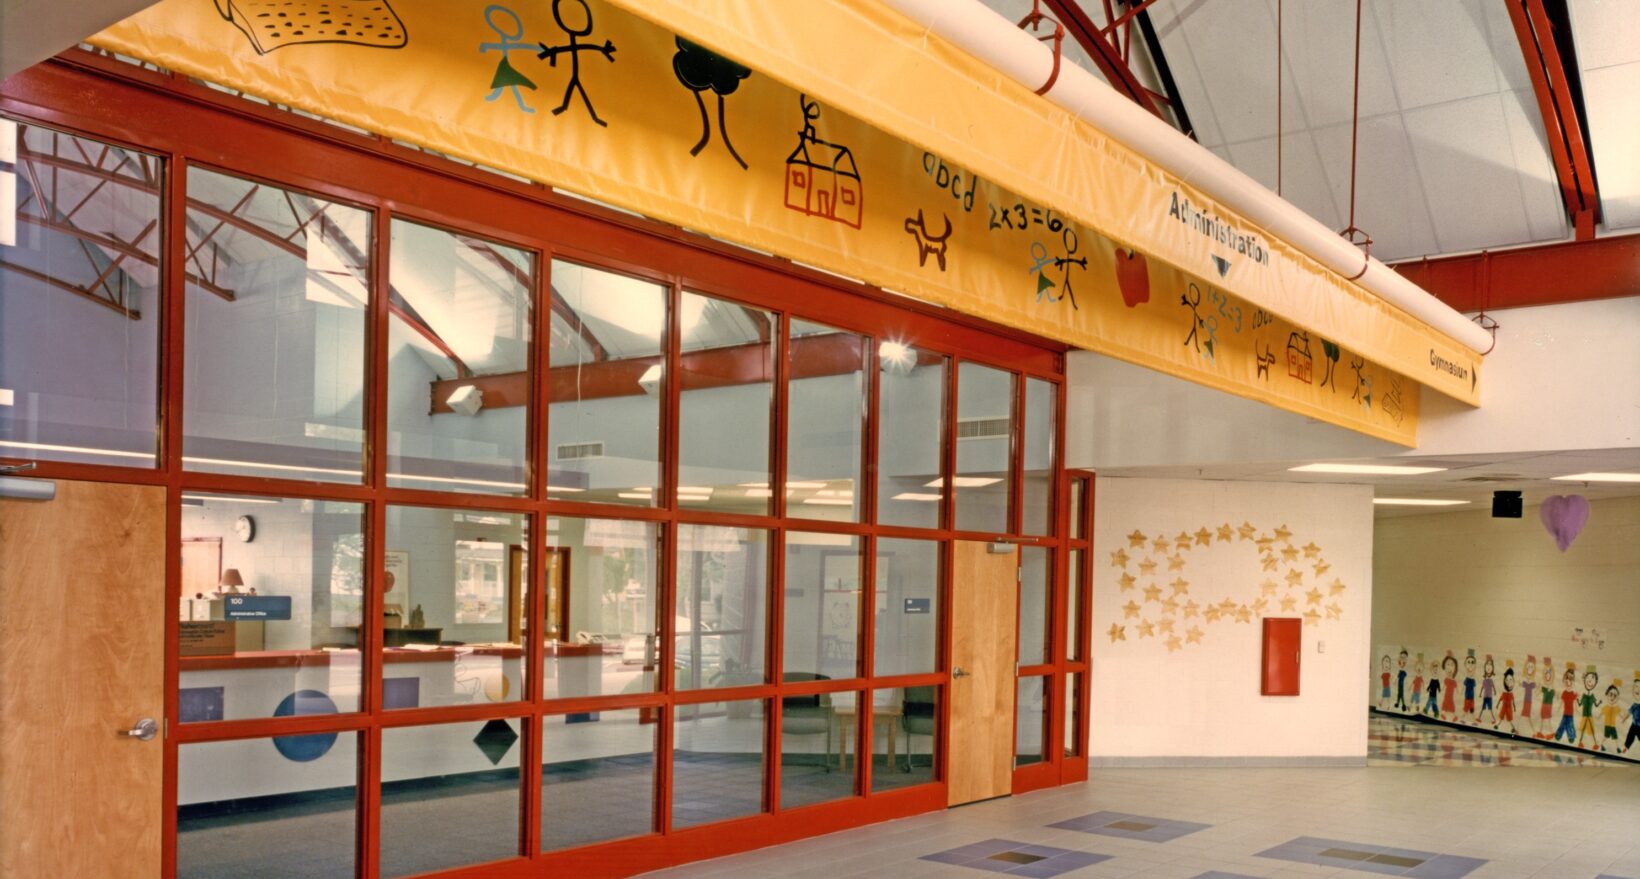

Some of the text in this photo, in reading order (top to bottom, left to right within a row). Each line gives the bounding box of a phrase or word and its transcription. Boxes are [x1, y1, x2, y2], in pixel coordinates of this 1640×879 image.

[923, 152, 977, 212] abcd
[1169, 191, 1269, 267] Administration
[1430, 348, 1468, 380] Gymnasium
